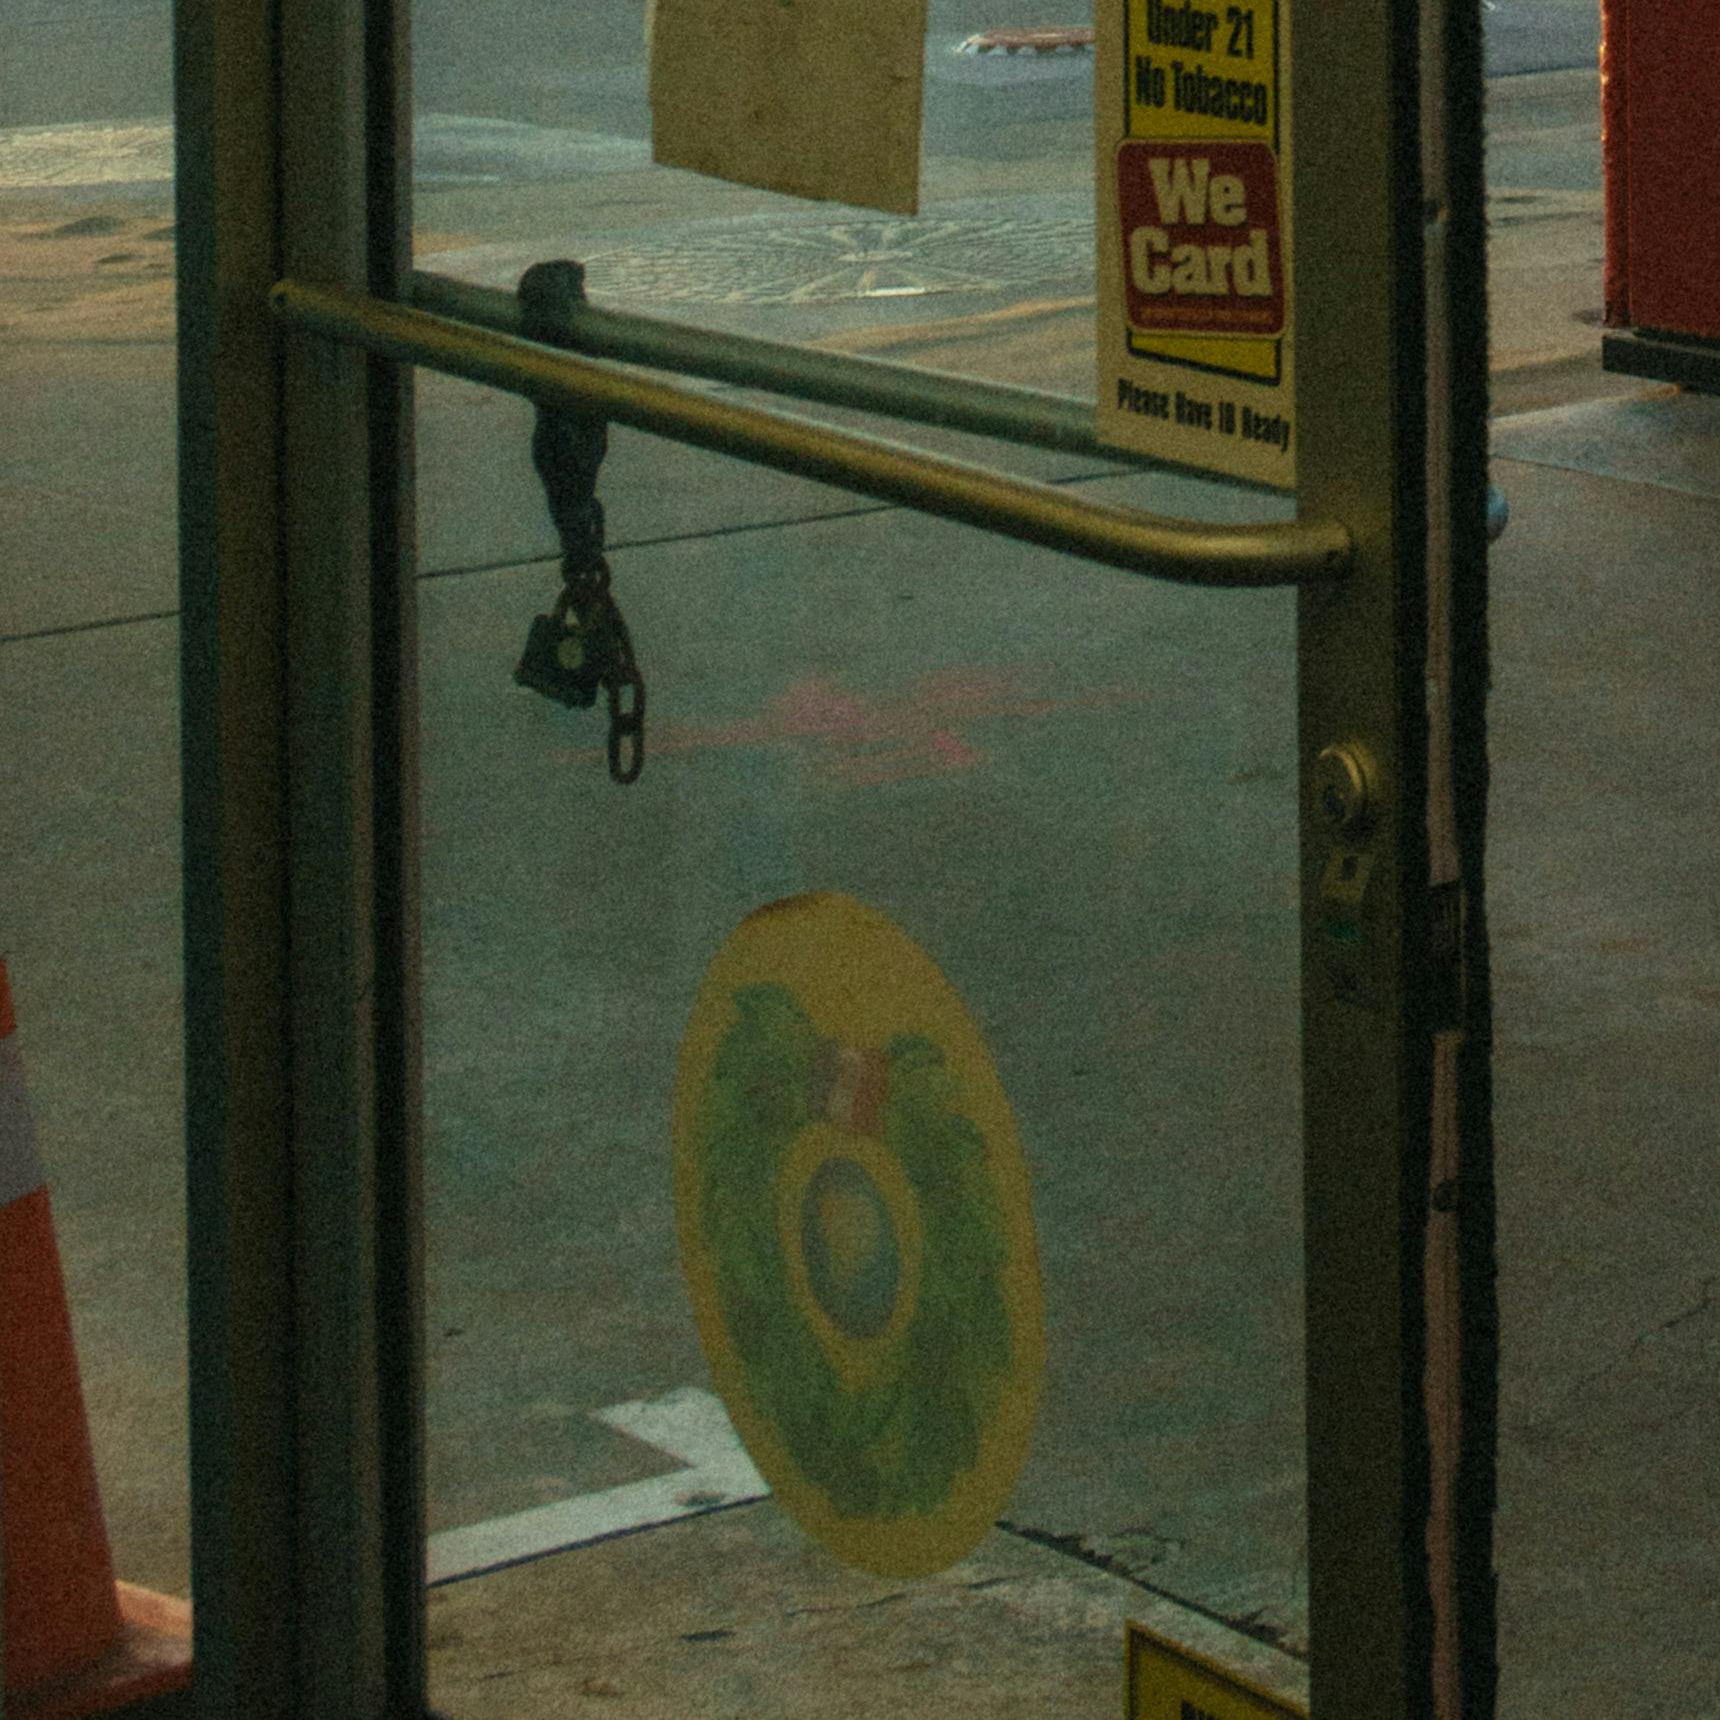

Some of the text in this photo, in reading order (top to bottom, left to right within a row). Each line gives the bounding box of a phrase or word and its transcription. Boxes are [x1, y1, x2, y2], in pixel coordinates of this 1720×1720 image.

[1226, 6, 1254, 60] 21
[1135, 56, 1267, 126] No Tobacco
[1148, 156, 1247, 228] We
[1129, 224, 1273, 297] Card
[1117, 378, 1291, 454] Please Have ID Ready
